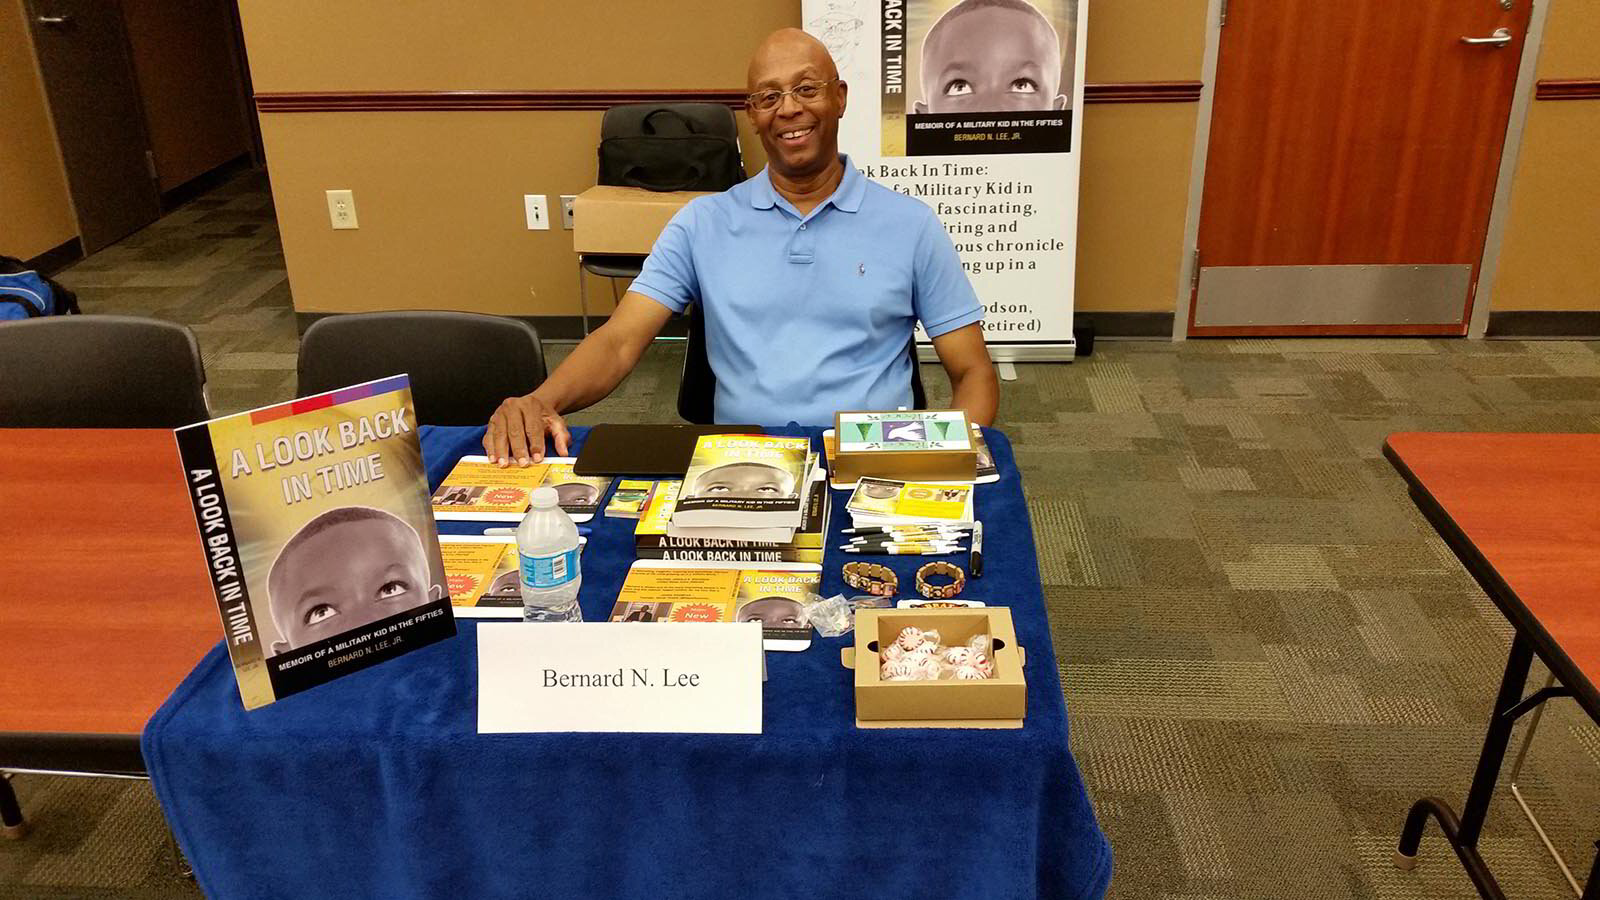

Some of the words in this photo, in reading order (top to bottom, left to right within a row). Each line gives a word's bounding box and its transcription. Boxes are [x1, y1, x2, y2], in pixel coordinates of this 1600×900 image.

[885, 34, 902, 50] IN
[886, 55, 902, 94] TIME
[880, 164, 918, 177] Back
[922, 164, 938, 176] In
[942, 163, 988, 176] Time:
[902, 186, 910, 196] a
[915, 182, 982, 198] Military
[986, 182, 1013, 195] Kid
[1017, 182, 1033, 194] in
[987, 220, 1017, 233] and
[987, 239, 1064, 252] chronicle
[985, 262, 1004, 273] up
[1009, 258, 1024, 270] in
[1028, 260, 1036, 270] a
[232, 448, 252, 479] A
[256, 426, 335, 472] LOOK
[338, 407, 410, 450] BACK
[716, 440, 762, 449] LOOK
[764, 440, 807, 450] BACK
[190, 469, 212, 483] A
[281, 472, 312, 505] IN
[316, 452, 385, 494] TIME
[196, 483, 226, 533] LOOK
[659, 537, 667, 547] A
[670, 537, 701, 547] LOOK
[704, 538, 734, 547] BACK
[207, 533, 238, 582] BACK
[663, 551, 671, 560] A
[674, 551, 704, 560] LOOK
[707, 551, 736, 561] BACK
[740, 551, 751, 561] IN
[754, 552, 782, 562] TIME
[220, 581, 242, 602] IN
[227, 601, 253, 646] TIME
[278, 654, 313, 672] MEMOIR
[314, 649, 326, 659] OF
[327, 646, 334, 654] A
[335, 633, 372, 651] MILITARY
[373, 628, 388, 638] KID
[388, 624, 397, 633] IN
[398, 619, 414, 630] THE
[414, 608, 444, 623] FIFTIES
[327, 647, 364, 668] BERNARD
[365, 645, 374, 654] N.
[375, 640, 391, 651] LEE,
[542, 668, 623, 687] Bernard
[631, 669, 654, 687] N.
[662, 668, 700, 687] Lee
